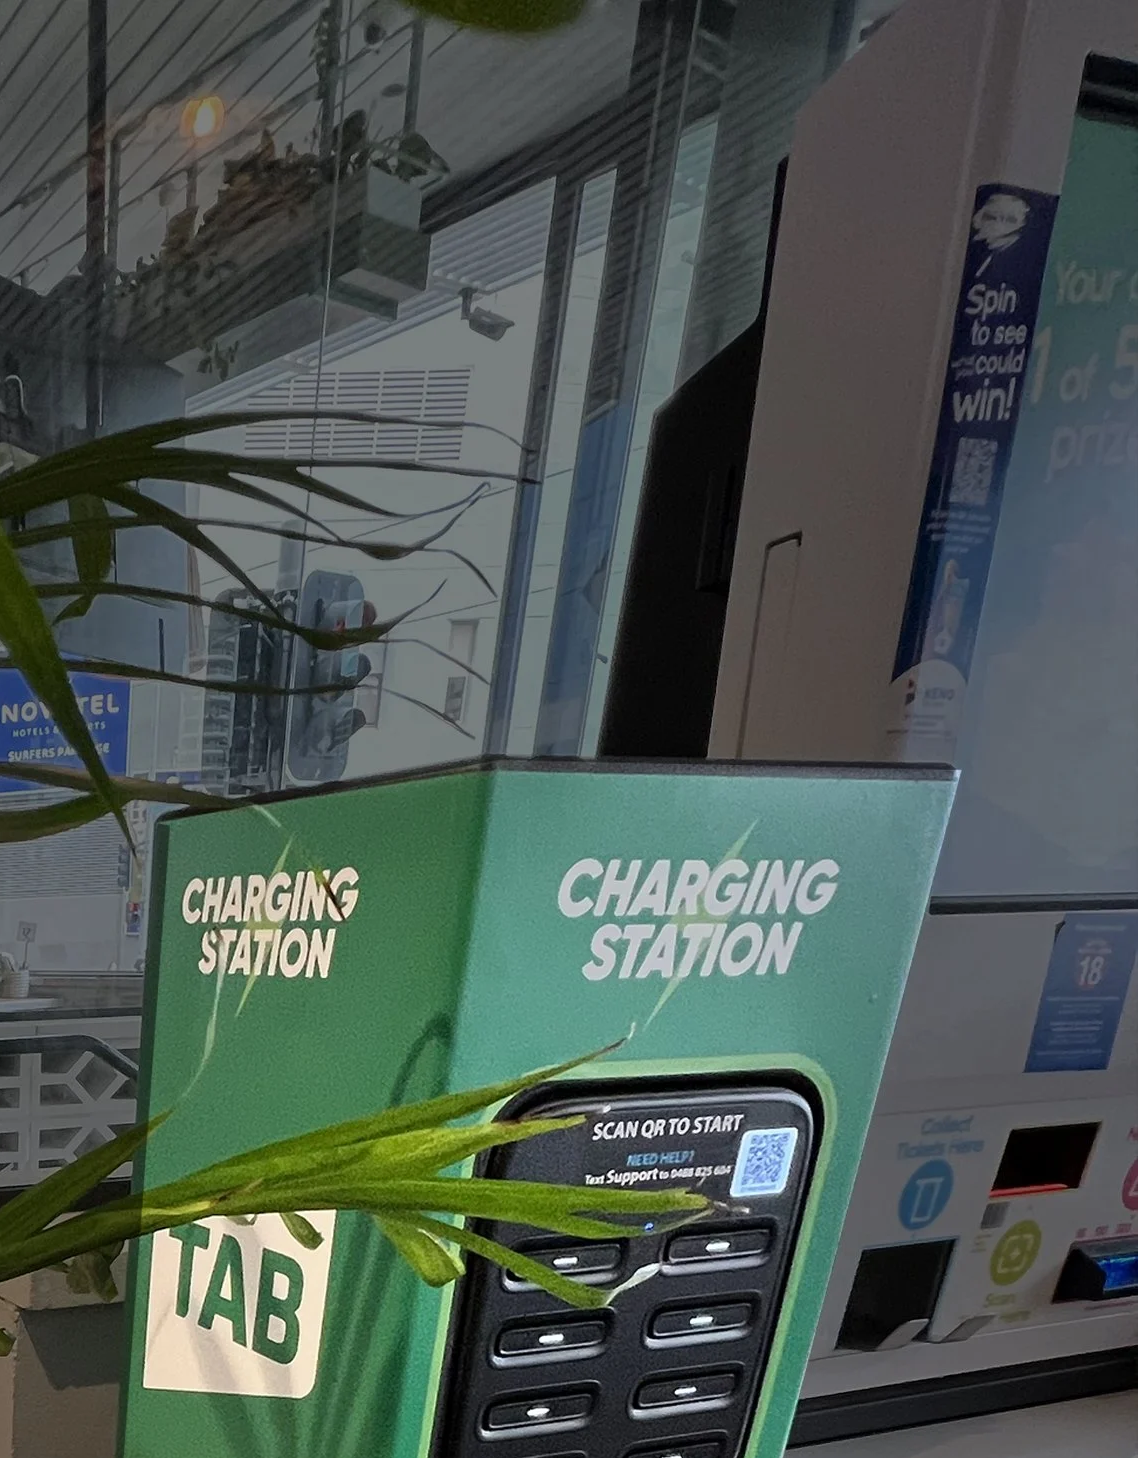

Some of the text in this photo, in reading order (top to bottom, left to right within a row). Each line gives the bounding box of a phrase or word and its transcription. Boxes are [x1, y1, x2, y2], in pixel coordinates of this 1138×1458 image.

[1056, 260, 1128, 306] Your
[964, 283, 1017, 321] Spin
[972, 320, 1027, 345] to see
[976, 349, 1025, 374] could
[1059, 352, 1100, 403] of
[953, 377, 1016, 423] win!
[1, 693, 119, 724] NOVTEL
[13, 726, 49, 737] HOTELS
[8, 747, 56, 762] SURFERS
[182, 866, 359, 924] CHARGING
[558, 858, 840, 918] CHARGING
[198, 928, 336, 978] STATION
[581, 921, 803, 981] STATION
[1080, 956, 1104, 985] 18
[592, 1114, 744, 1141] SCAN QR TO START
[585, 1173, 604, 1185] Text
[606, 1168, 658, 1186] Support
[659, 1170, 669, 1179] to
[626, 1153, 658, 1167] NEED
[169, 1223, 304, 1364] TAB
